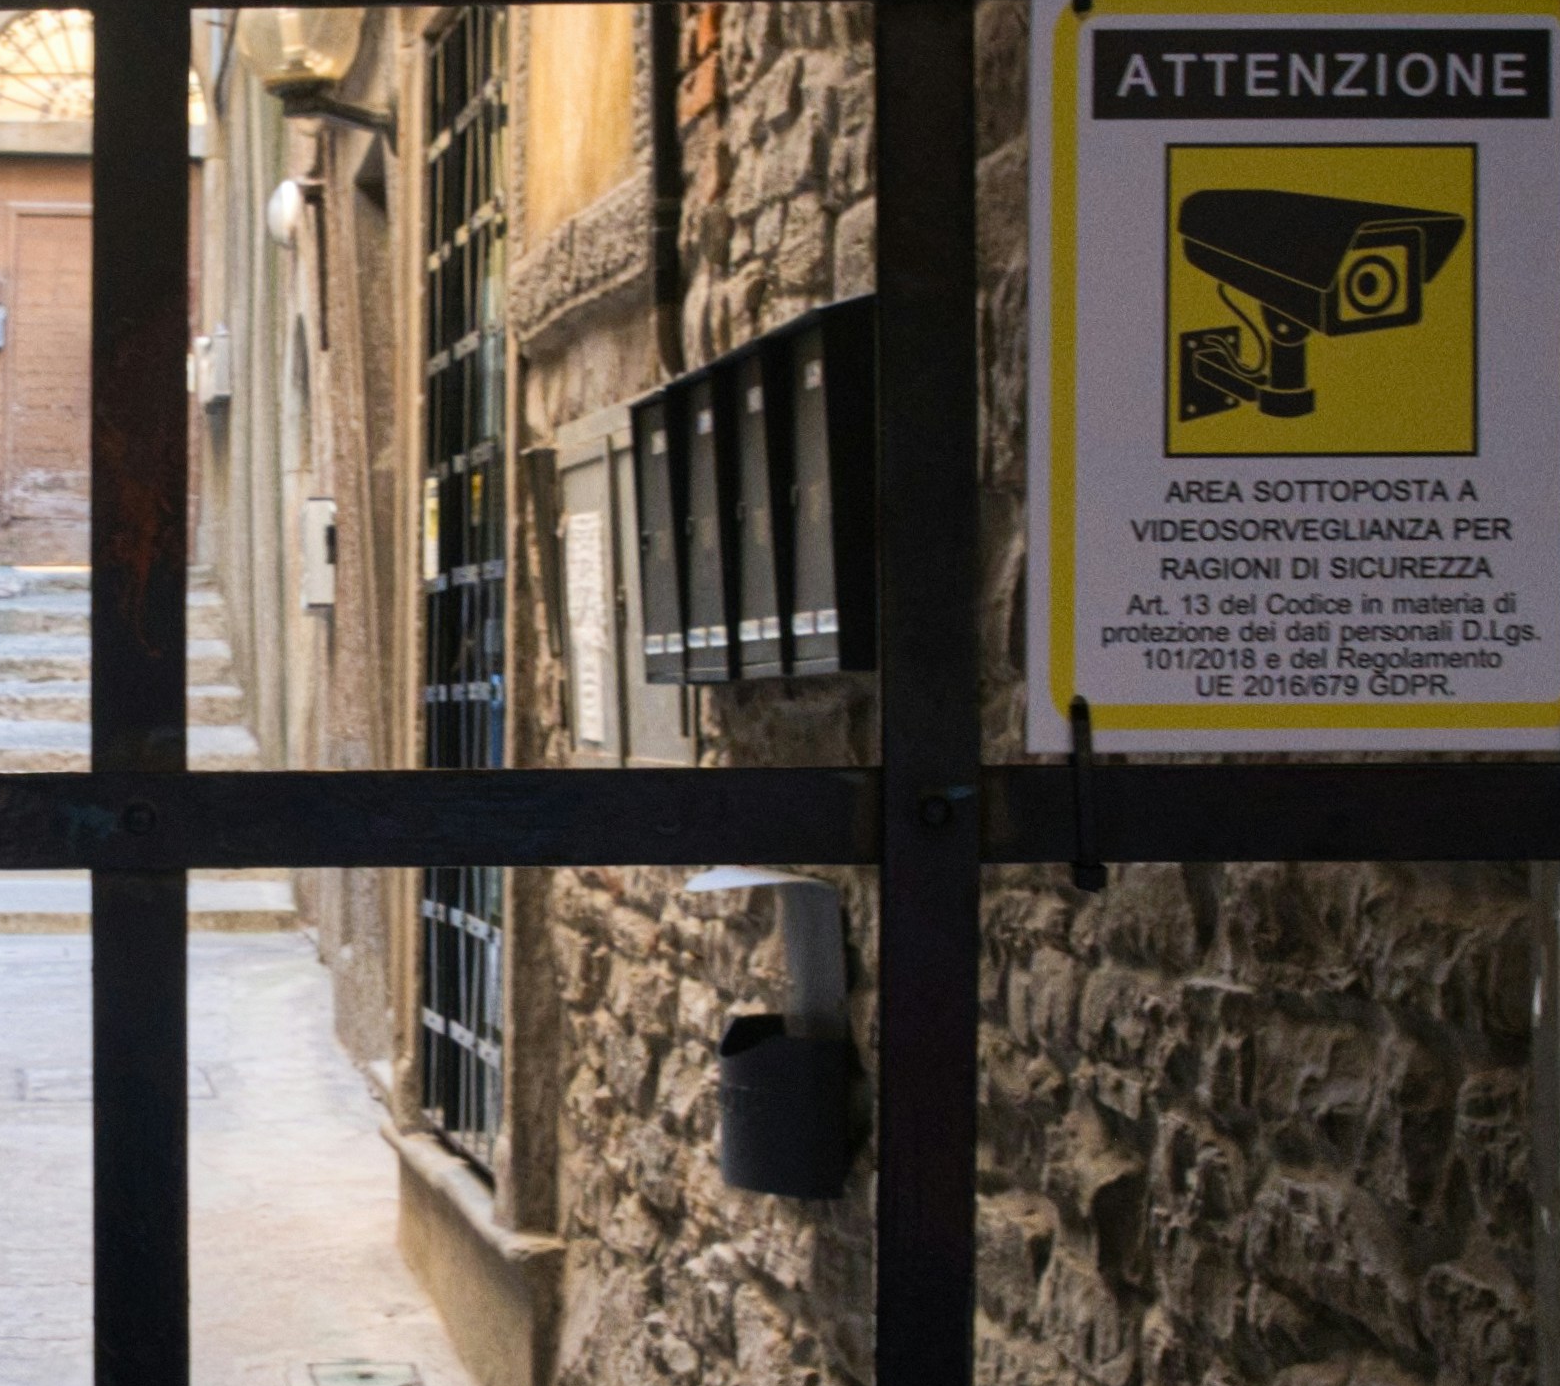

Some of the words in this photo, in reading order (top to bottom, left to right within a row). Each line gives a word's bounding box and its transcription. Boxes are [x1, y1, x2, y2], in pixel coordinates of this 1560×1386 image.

[1116, 53, 1529, 96] ATTENZIONE
[1165, 480, 1244, 504] AREA
[1252, 479, 1450, 503] SOTTOPOSTA
[1457, 479, 1479, 502] A
[1130, 518, 1443, 543] VIDEOSORVEGLIANZA
[1453, 518, 1513, 541] PER
[1160, 557, 1280, 580] RAGIONI
[1291, 556, 1319, 580] DI
[1329, 556, 1494, 580] SICUREZZA
[1126, 593, 1169, 616] Art.
[1182, 593, 1210, 615] 13
[1219, 592, 1256, 615] del
[1266, 592, 1352, 615] Codice
[1361, 593, 1382, 615] in
[1392, 593, 1485, 615] materia
[1493, 592, 1517, 615] di
[1101, 621, 1229, 647] protezione
[1239, 620, 1276, 643] dei
[1285, 620, 1331, 643] dati
[1340, 620, 1454, 649] personali
[1462, 619, 1541, 646] D.Lgs.
[1142, 648, 1256, 671] 101/2018
[1266, 653, 1281, 670] e
[1290, 647, 1327, 670] del
[1336, 647, 1503, 673] Regolamento
[1195, 675, 1233, 698] UE
[1243, 674, 1359, 697] 2016/679
[1367, 673, 1457, 697] GDPR.
